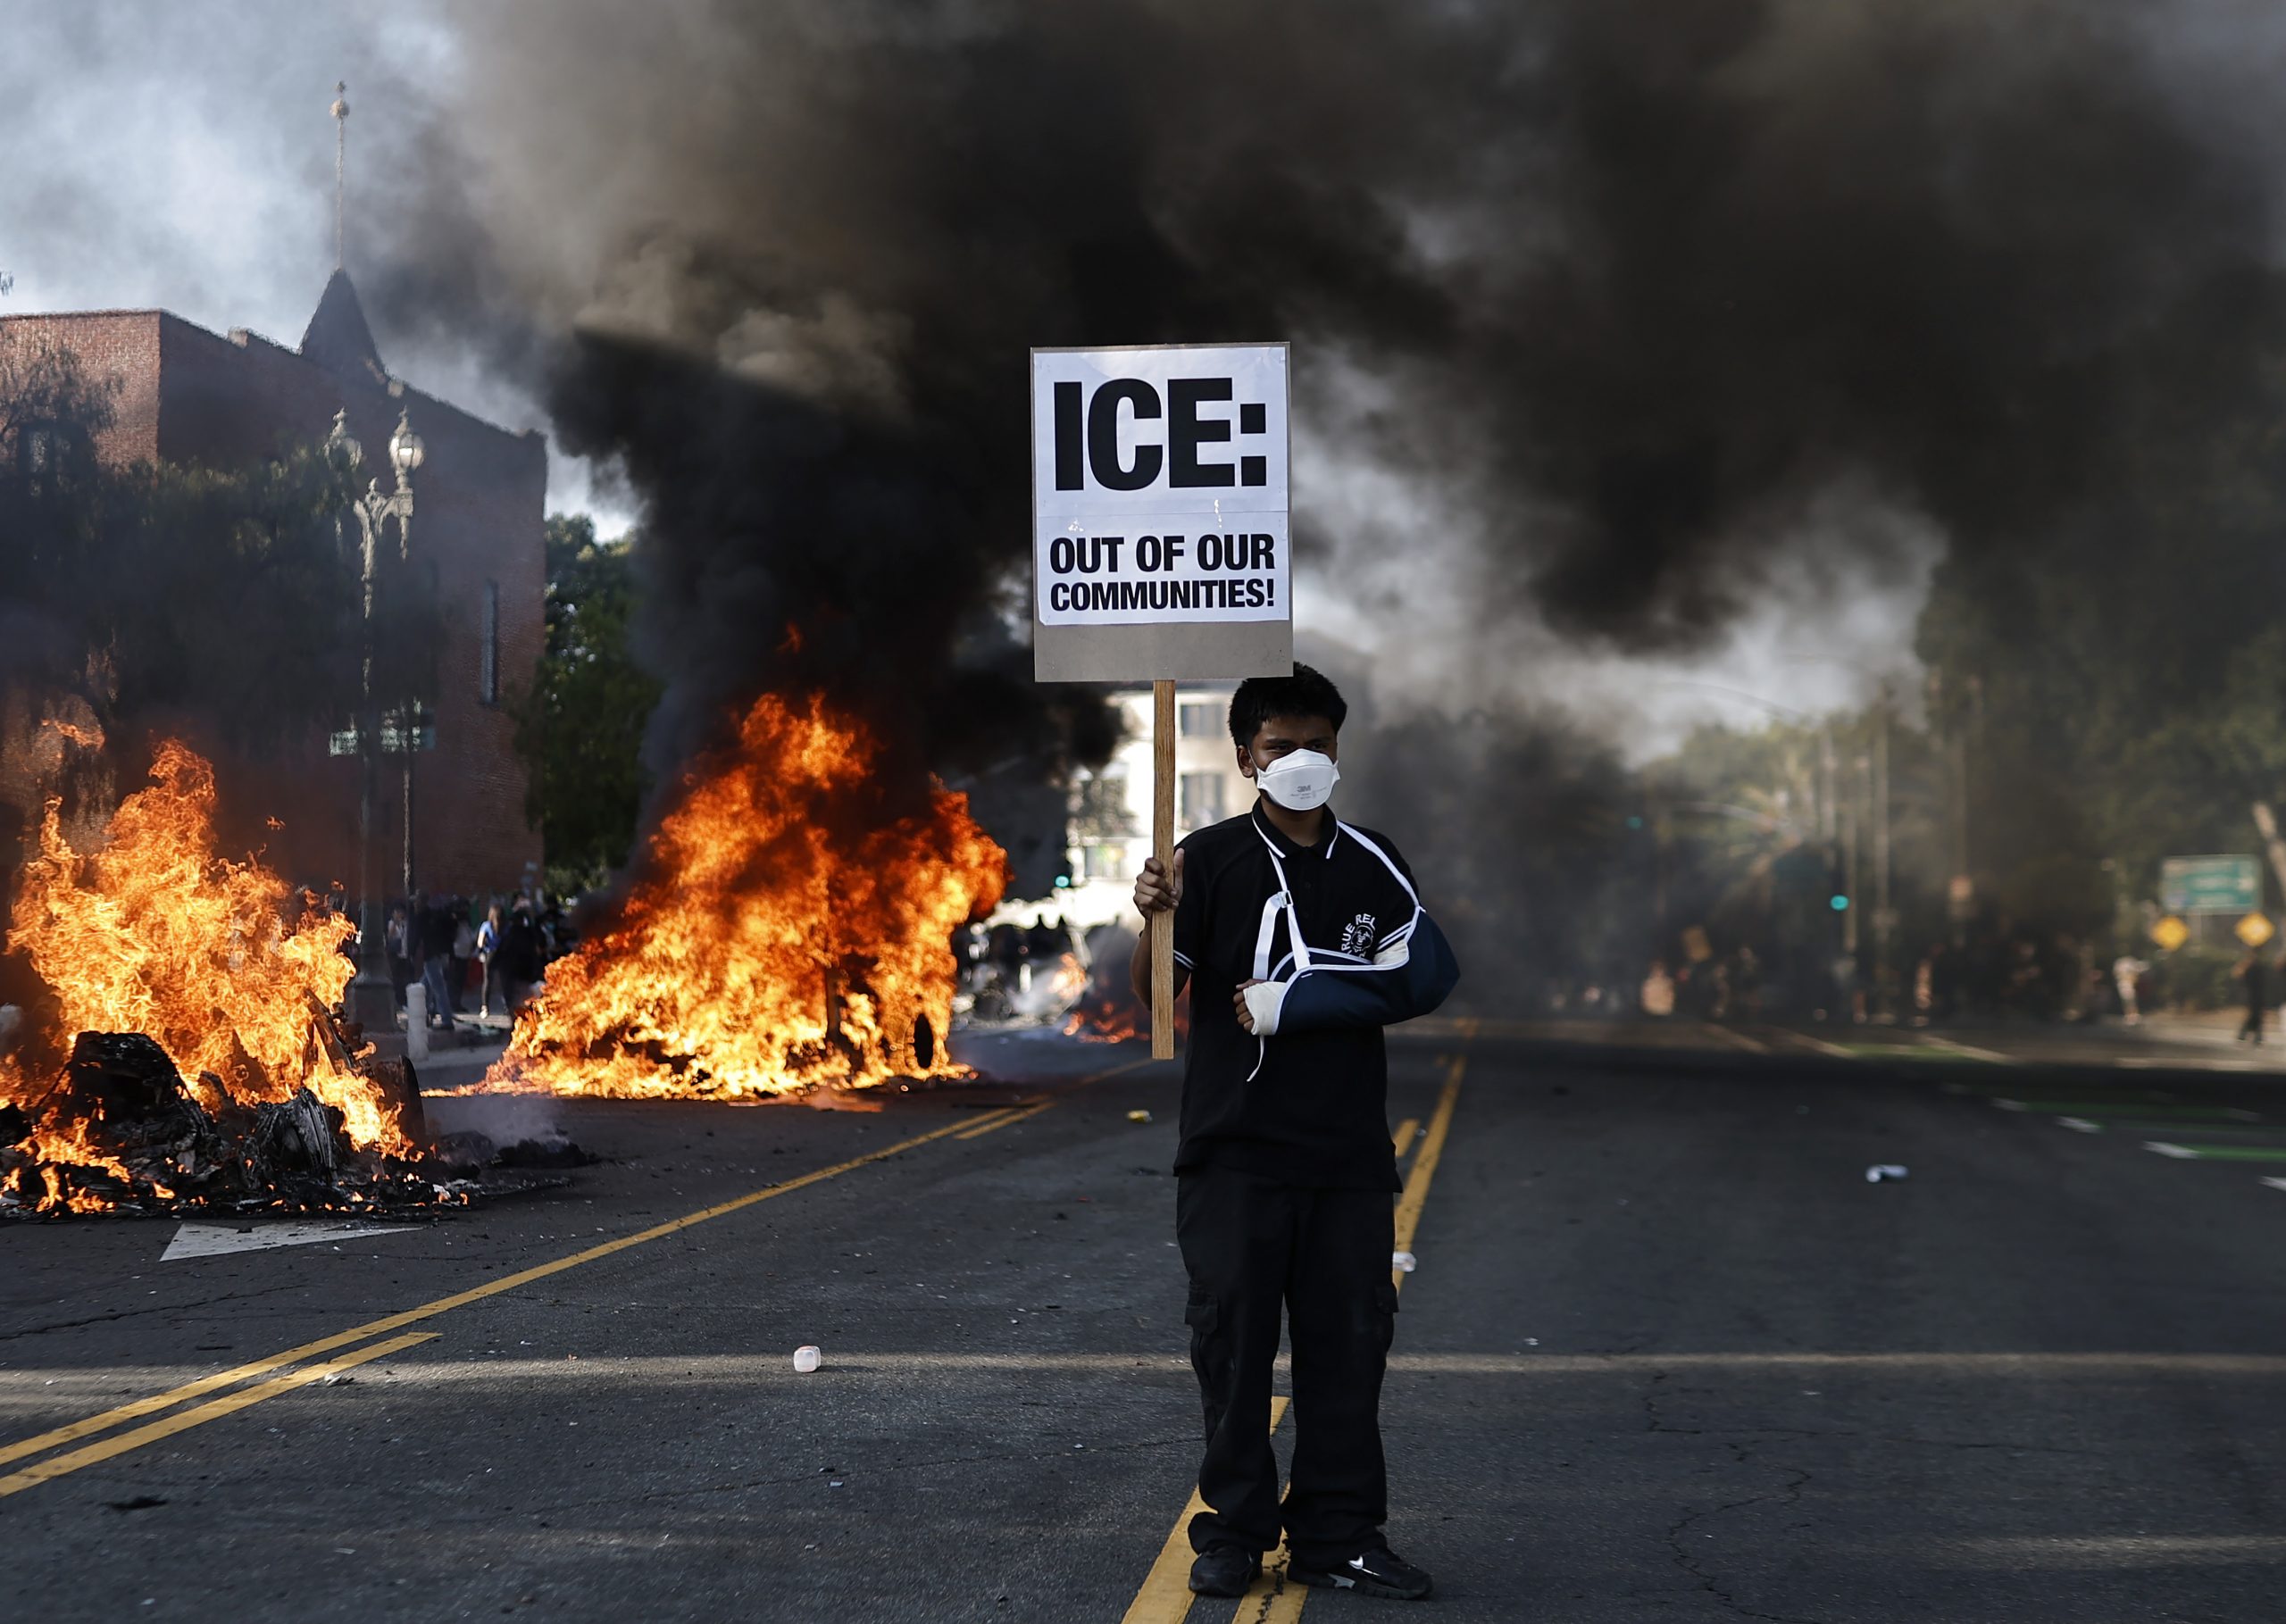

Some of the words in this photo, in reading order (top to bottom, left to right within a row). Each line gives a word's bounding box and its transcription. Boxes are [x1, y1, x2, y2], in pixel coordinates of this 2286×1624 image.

[1054, 378, 1267, 491] ICE:
[1050, 537, 1124, 574] OUT
[1136, 536, 1185, 571] OF
[1197, 534, 1275, 570] OUR
[1050, 579, 1274, 611] COMMUNITIES!
[1297, 785, 1312, 793] 3M
[1341, 922, 1356, 954] RUE
